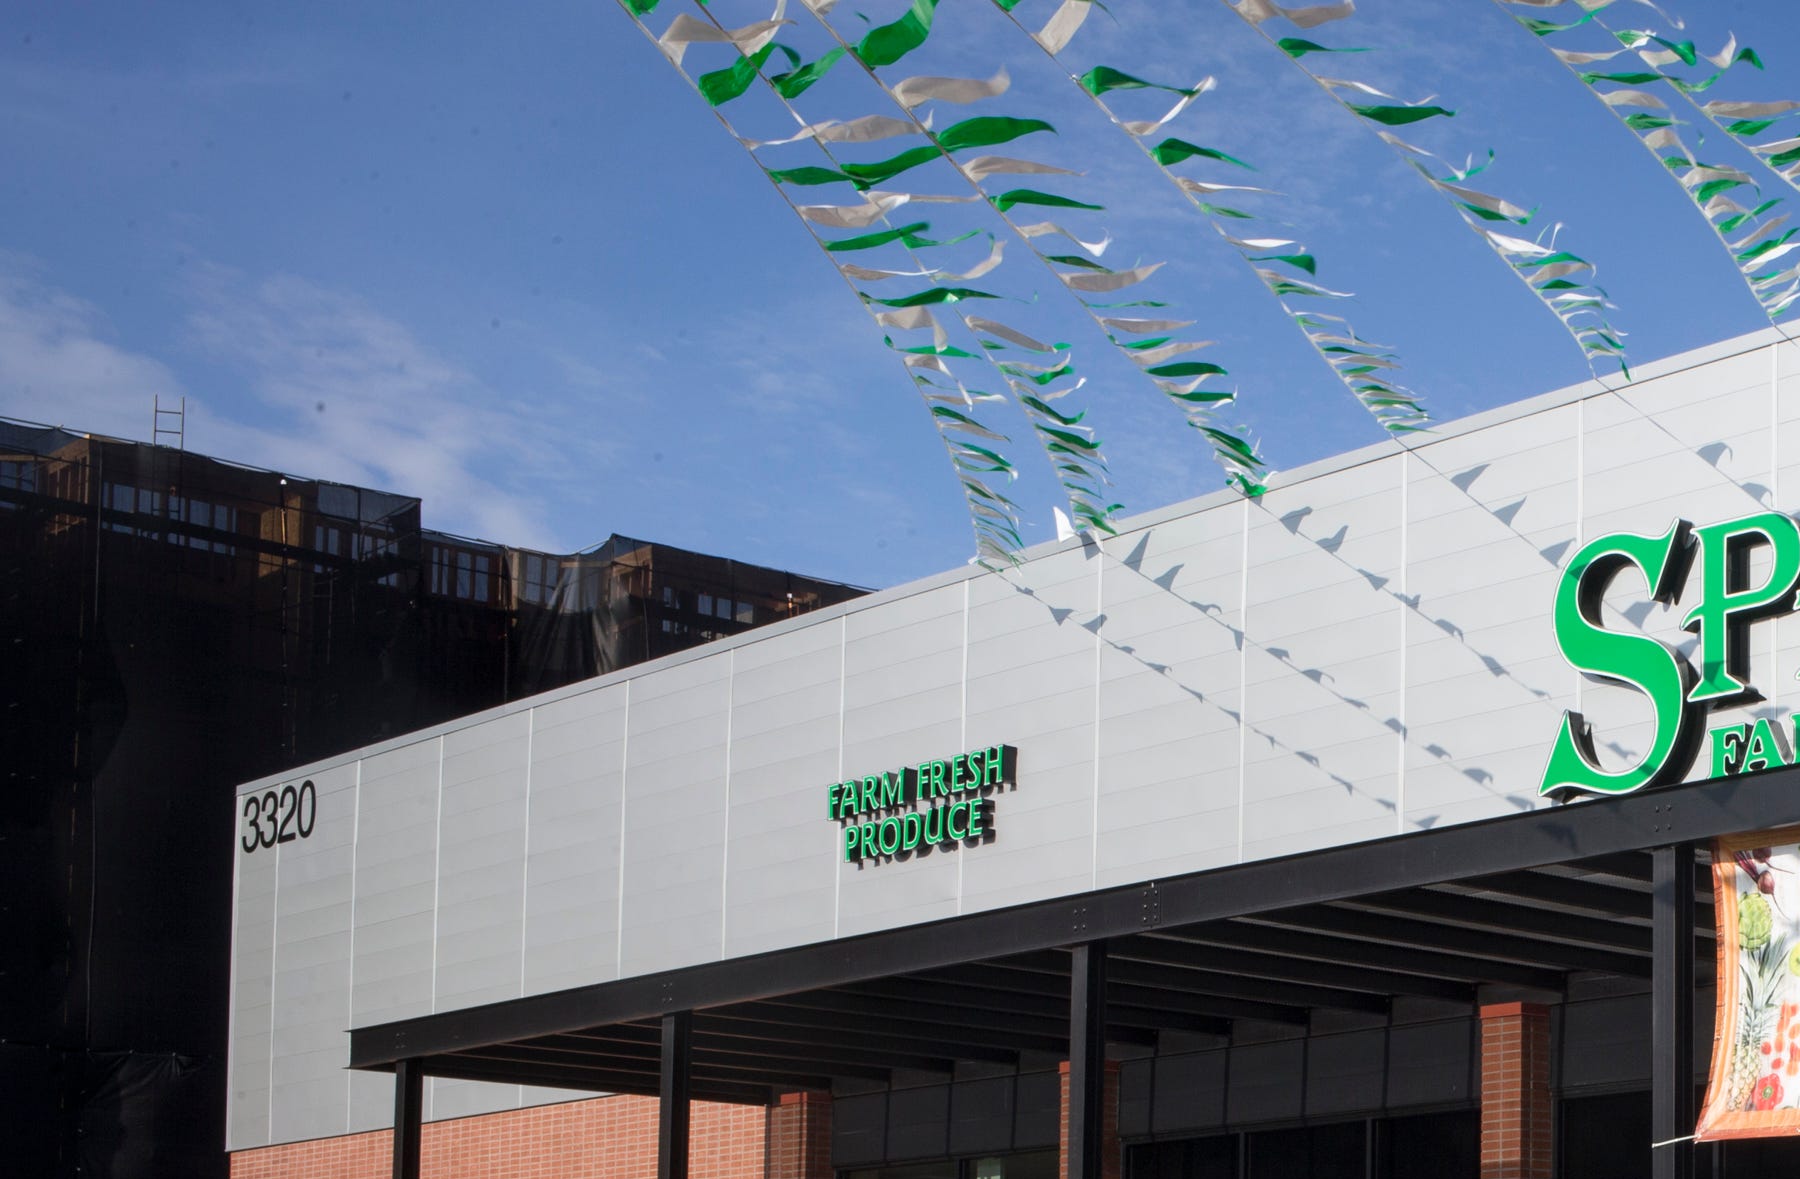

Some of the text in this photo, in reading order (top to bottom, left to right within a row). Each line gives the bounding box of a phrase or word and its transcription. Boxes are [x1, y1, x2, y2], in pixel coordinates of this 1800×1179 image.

[242, 780, 316, 853] 3320
[828, 743, 1004, 820] FARM FRESH
[844, 797, 984, 862] PRODUCE
